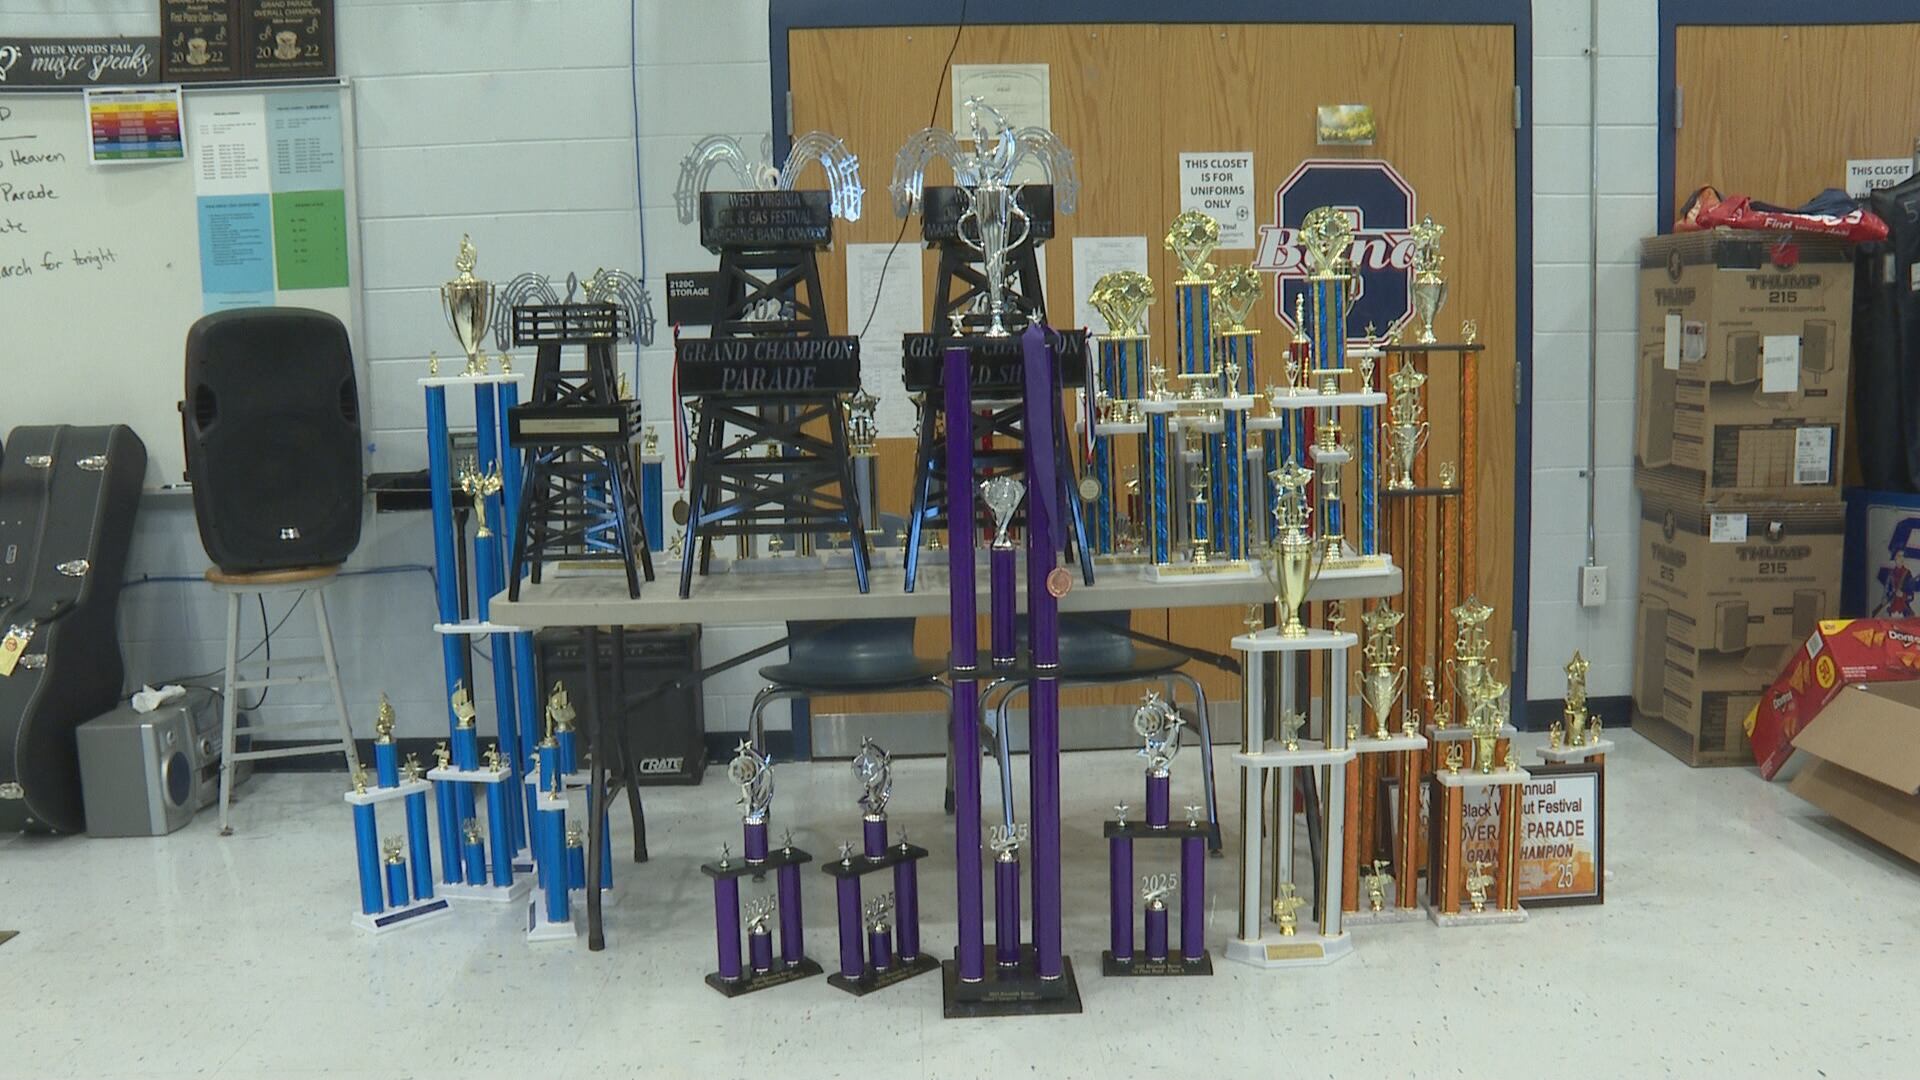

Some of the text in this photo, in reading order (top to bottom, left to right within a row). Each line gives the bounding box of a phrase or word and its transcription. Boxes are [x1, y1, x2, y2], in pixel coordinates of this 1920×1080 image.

[30, 44, 133, 54] WHEN WORDS FAIL
[256, 45, 319, 59] 20 22
[31, 43, 154, 81] music speaks
[171, 52, 224, 62] 20 22
[10, 149, 65, 167] Heaven
[1185, 159, 1248, 169] THIS CLOSET
[1201, 173, 1233, 182] IS FOR
[1852, 165, 1910, 175] THIS CLOSET
[1190, 186, 1245, 196] UNIFORMS
[1865, 179, 1895, 188] IS FOR
[0, 182, 59, 202] Parade
[729, 193, 800, 207] WEST VIRGINIA
[1204, 199, 1231, 208] ONLY
[749, 210, 768, 224] GAS
[771, 209, 811, 224] FESTIVAL
[1764, 217, 1793, 230] Find
[0, 247, 115, 280] arch for tonight
[1746, 274, 1821, 290] THUMP
[670, 288, 709, 297] STORAGE
[1769, 291, 1797, 303] 215
[682, 340, 853, 362] GRAND CHAMPION
[722, 367, 817, 392] PARADE
[1759, 562, 1787, 574] 215
[639, 757, 684, 774] CRATE
[1538, 797, 1582, 813] Festival
[990, 822, 1028, 844] 2025
[1528, 820, 1584, 839] PARADE
[1520, 844, 1574, 860] HAMPION
[1142, 872, 1178, 893] 2025
[1558, 863, 1573, 889] 25
